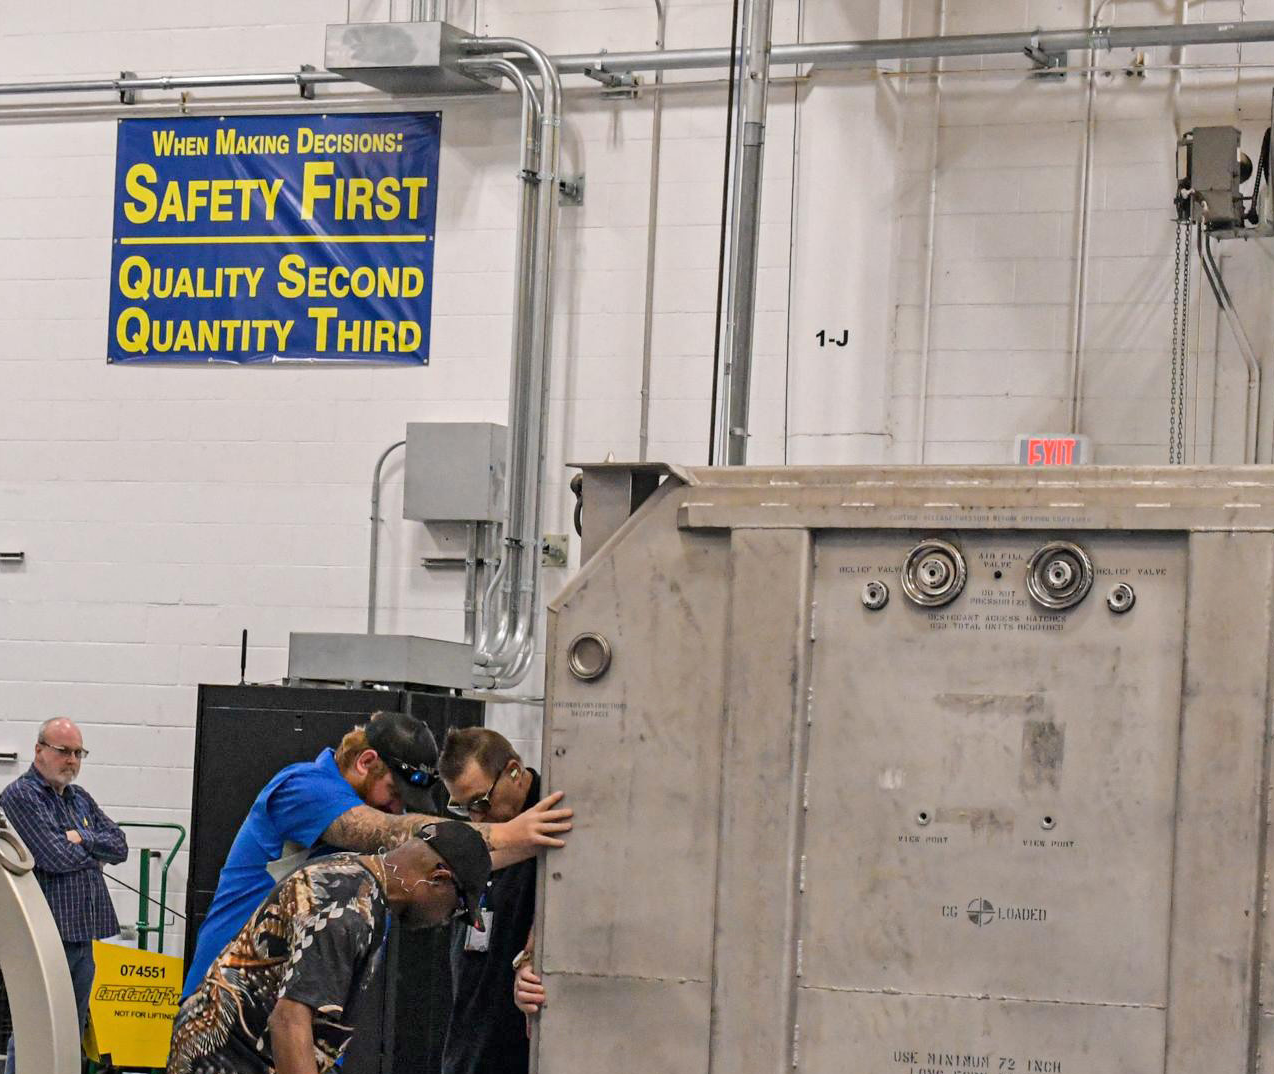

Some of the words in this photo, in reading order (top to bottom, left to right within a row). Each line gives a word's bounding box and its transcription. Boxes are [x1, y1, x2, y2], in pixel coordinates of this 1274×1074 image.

[152, 129, 208, 156] WHEN
[215, 128, 290, 155] MAKING
[297, 127, 404, 154] DECISIONS:
[123, 163, 284, 224] SAFETY
[300, 161, 428, 221] FIRST
[118, 255, 265, 301] QUALITY
[277, 254, 425, 299] SECOND
[116, 306, 295, 355] QUANTITY
[308, 307, 422, 353] THIRD
[815, 329, 849, 347] 1-J
[1028, 438, 1076, 465] EXIT
[839, 566, 871, 574] RELIEF
[1096, 568, 1131, 576] RELIEF
[1138, 568, 1167, 576] VALVE
[898, 835, 920, 843] VIEW
[925, 836, 948, 844] PORT
[1023, 839, 1045, 847] VIEW
[1051, 840, 1075, 848] PORT
[942, 905, 958, 918] CG
[998, 907, 1047, 921] LOADED
[120, 964, 166, 979] 074551
[130, 1010, 146, 1018] FOR
[893, 1051, 918, 1064] USE
[927, 1052, 989, 1069] MINIMUM
[998, 1057, 1016, 1071] 72
[1027, 1059, 1062, 1073] INCH
